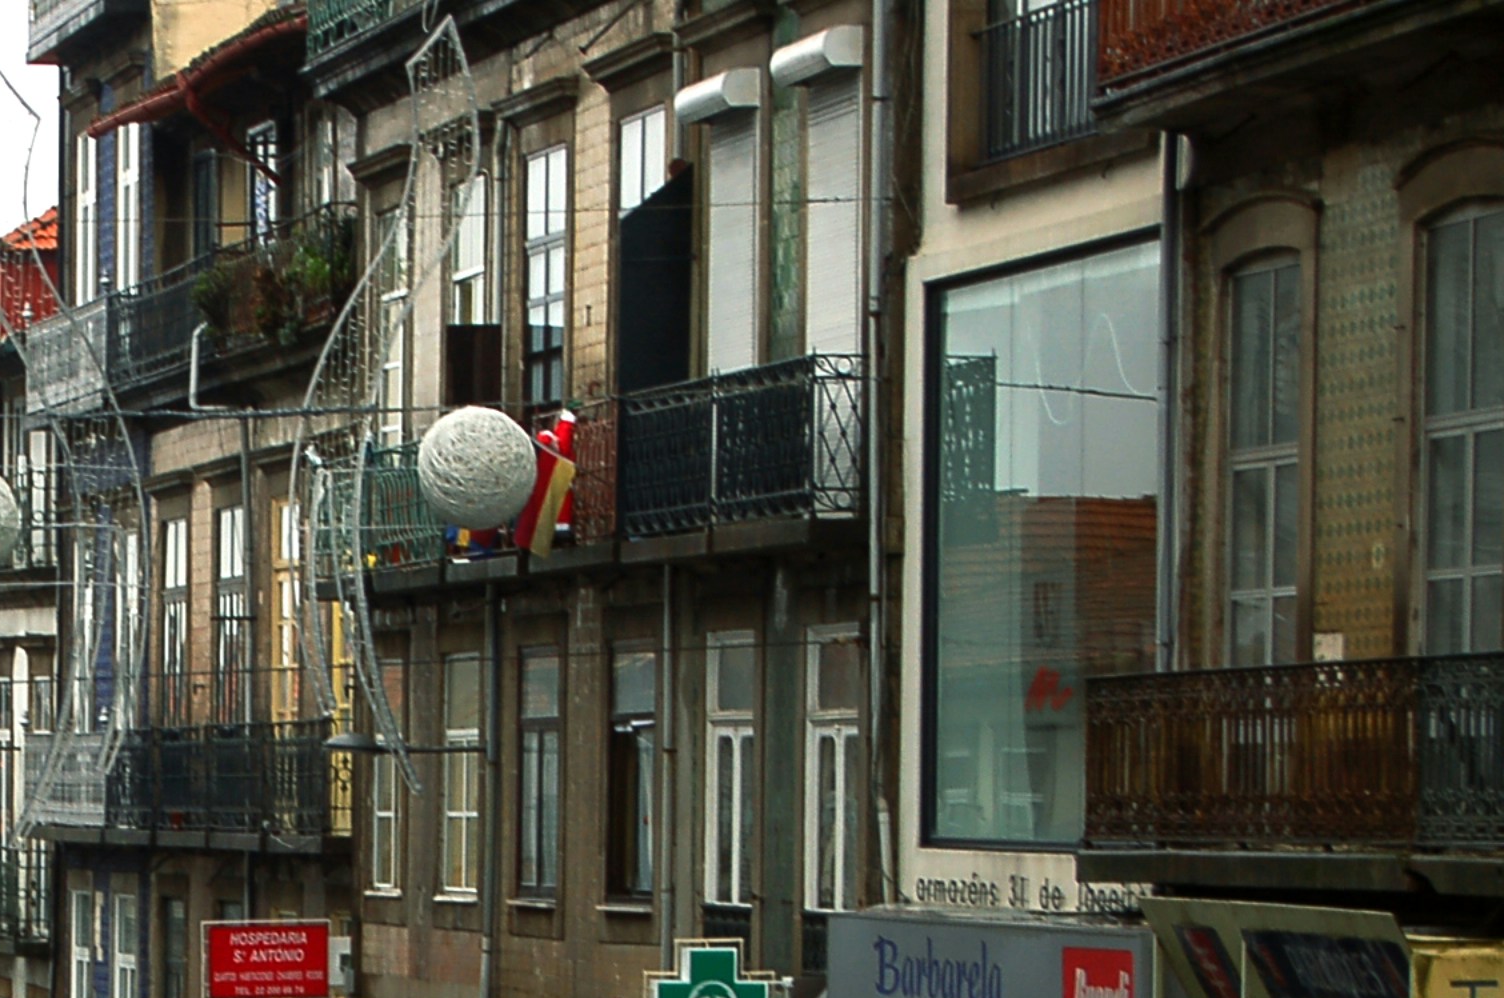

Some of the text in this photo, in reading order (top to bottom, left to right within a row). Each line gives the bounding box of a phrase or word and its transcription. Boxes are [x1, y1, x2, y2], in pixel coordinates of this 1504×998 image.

[916, 872, 997, 905] armazéns
[1039, 878, 1065, 910] de
[230, 932, 308, 946] HOSPEDARIA
